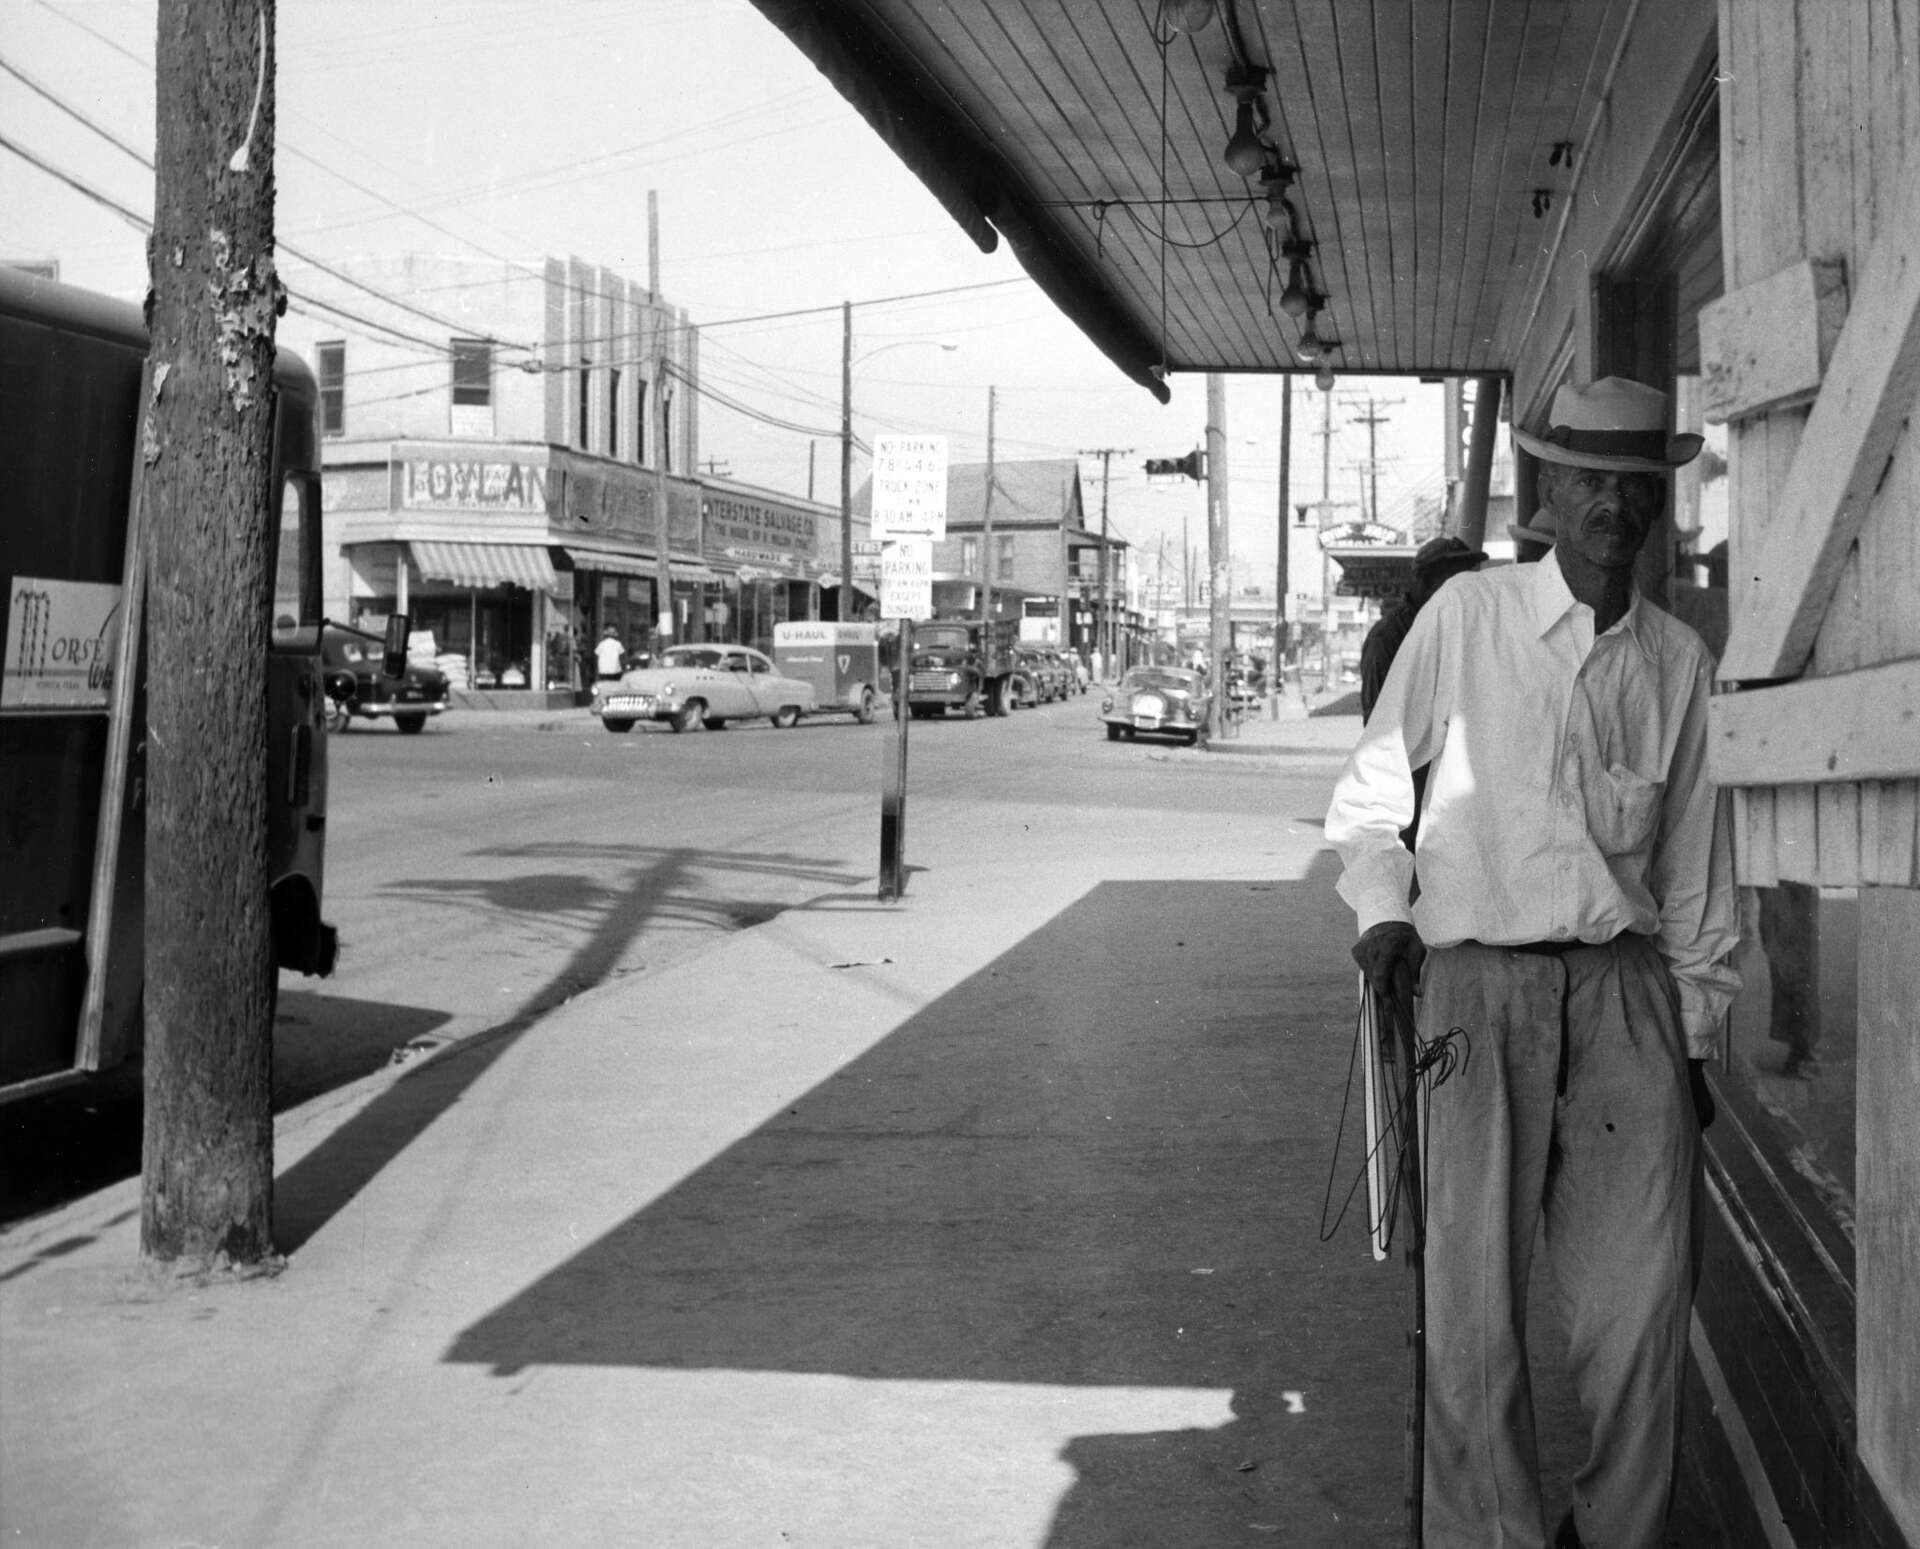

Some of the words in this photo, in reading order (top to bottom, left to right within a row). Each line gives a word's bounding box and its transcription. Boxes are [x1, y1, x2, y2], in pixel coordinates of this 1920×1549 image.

[880, 441, 895, 455] NO
[880, 479, 909, 494] TRUCK
[899, 544, 913, 558] NO
[884, 560, 929, 576] PARKING
